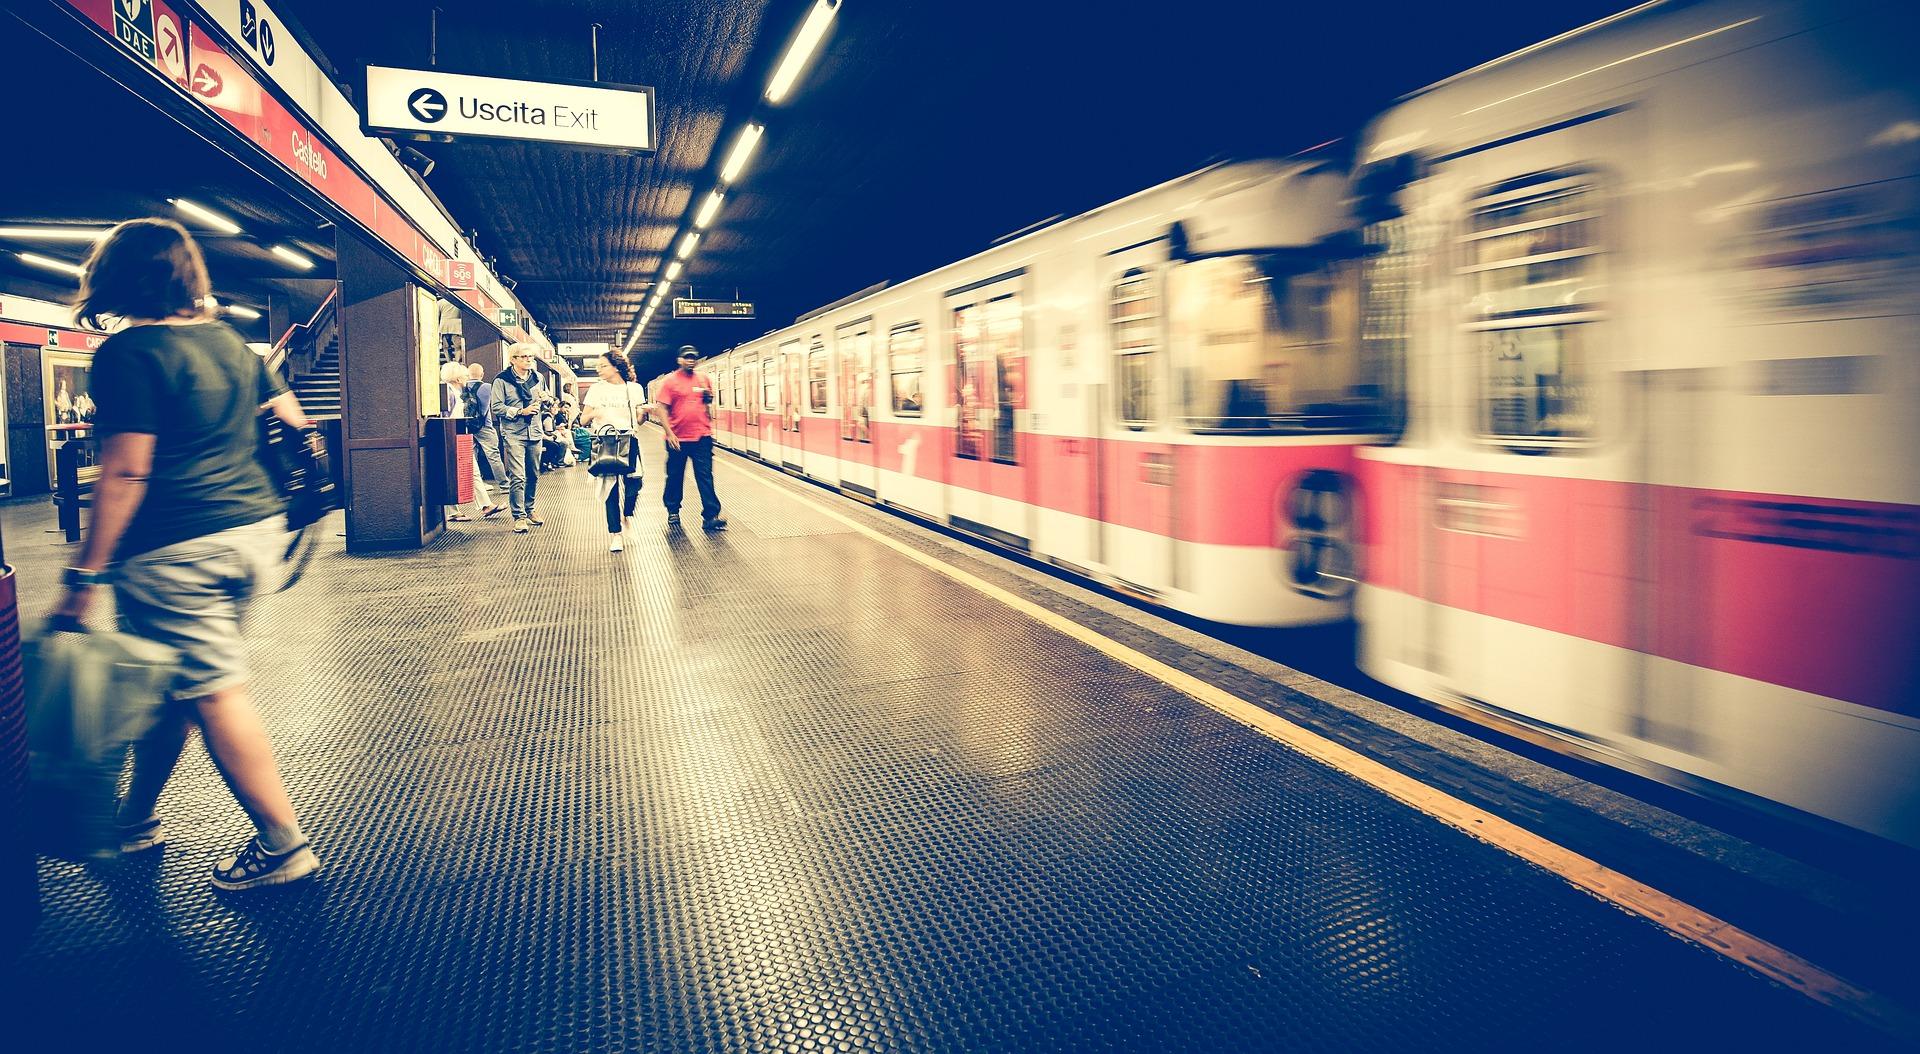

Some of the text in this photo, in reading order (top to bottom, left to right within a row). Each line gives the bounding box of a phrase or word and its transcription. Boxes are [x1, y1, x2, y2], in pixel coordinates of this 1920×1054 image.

[122, 22, 150, 58] DAE
[459, 96, 599, 131] Uscita Exit
[291, 130, 327, 180] Castello
[453, 270, 472, 280] SOS
[896, 431, 922, 476] 1
